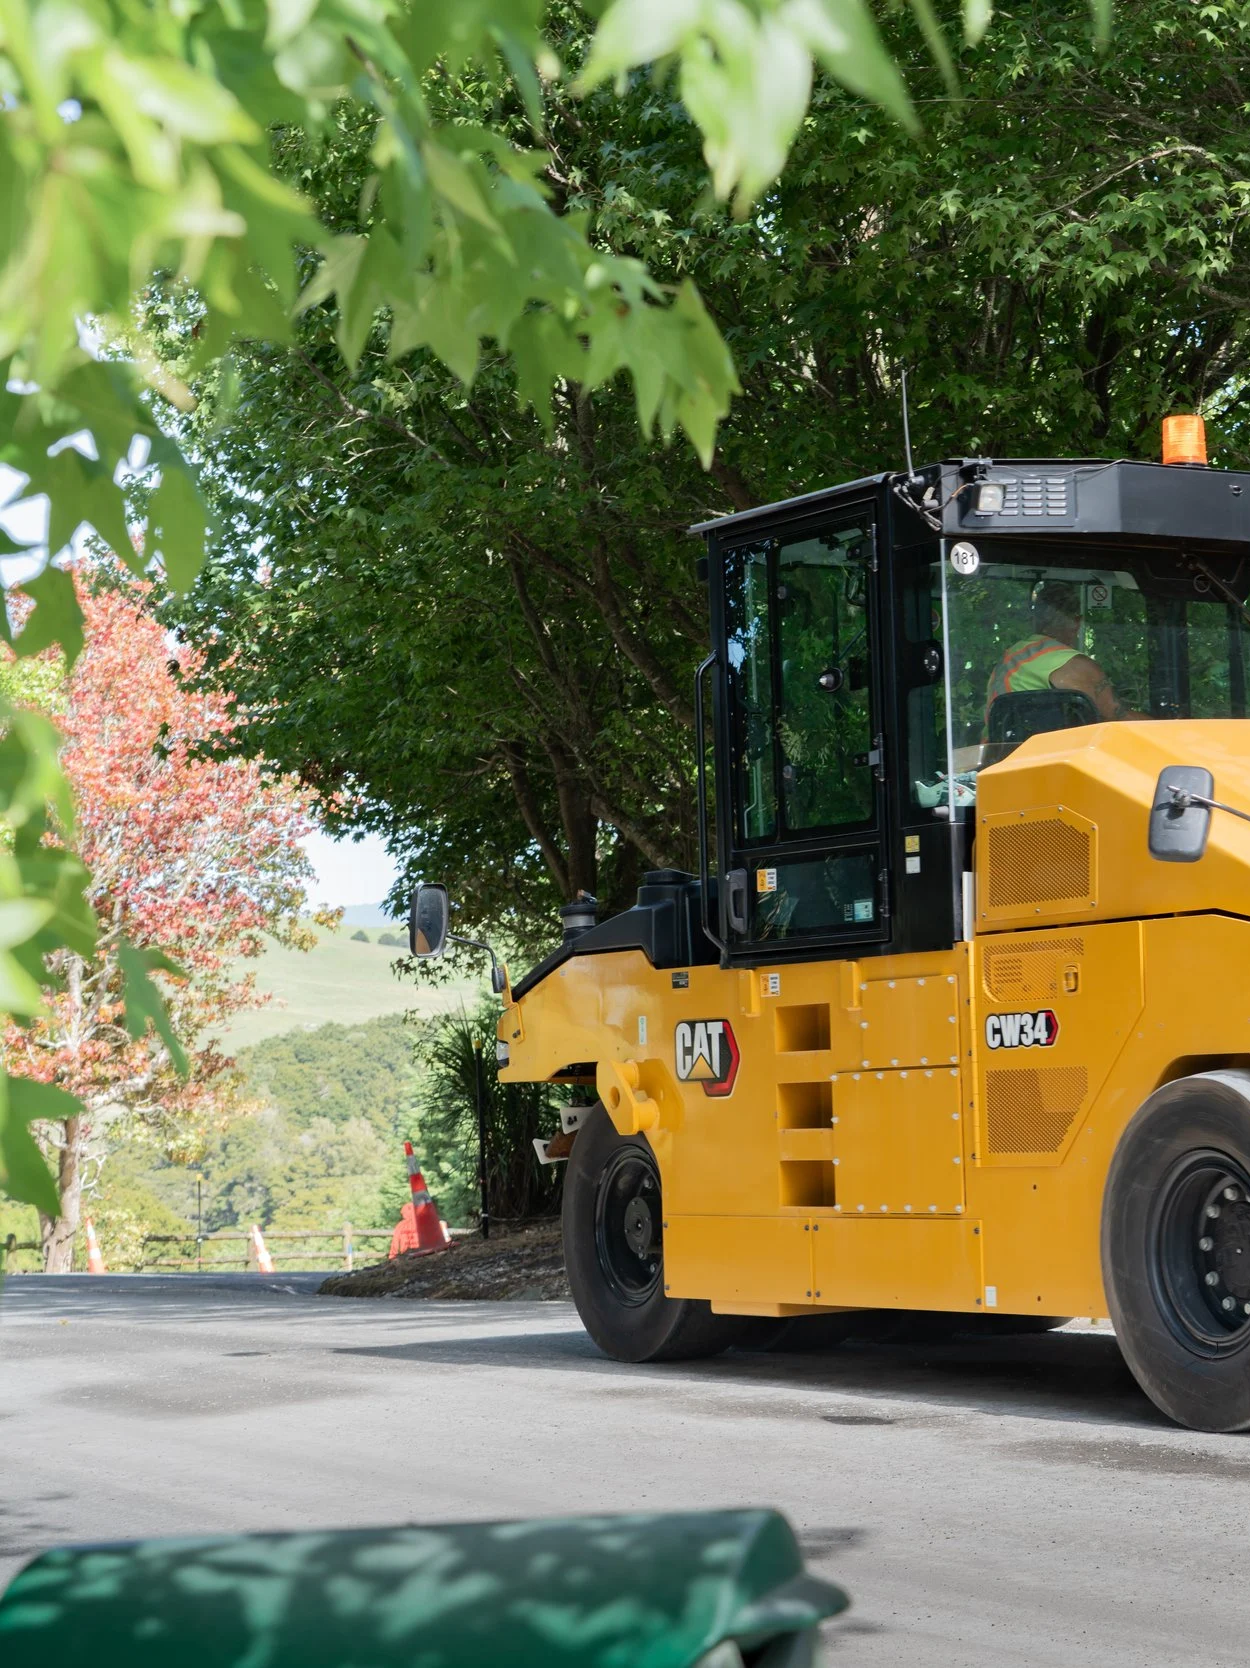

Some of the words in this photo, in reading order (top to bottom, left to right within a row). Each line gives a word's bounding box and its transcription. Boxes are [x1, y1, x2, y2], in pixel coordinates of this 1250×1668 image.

[954, 552, 975, 565] 181
[985, 1012, 1048, 1049] CW34
[675, 1021, 724, 1080] CAT
